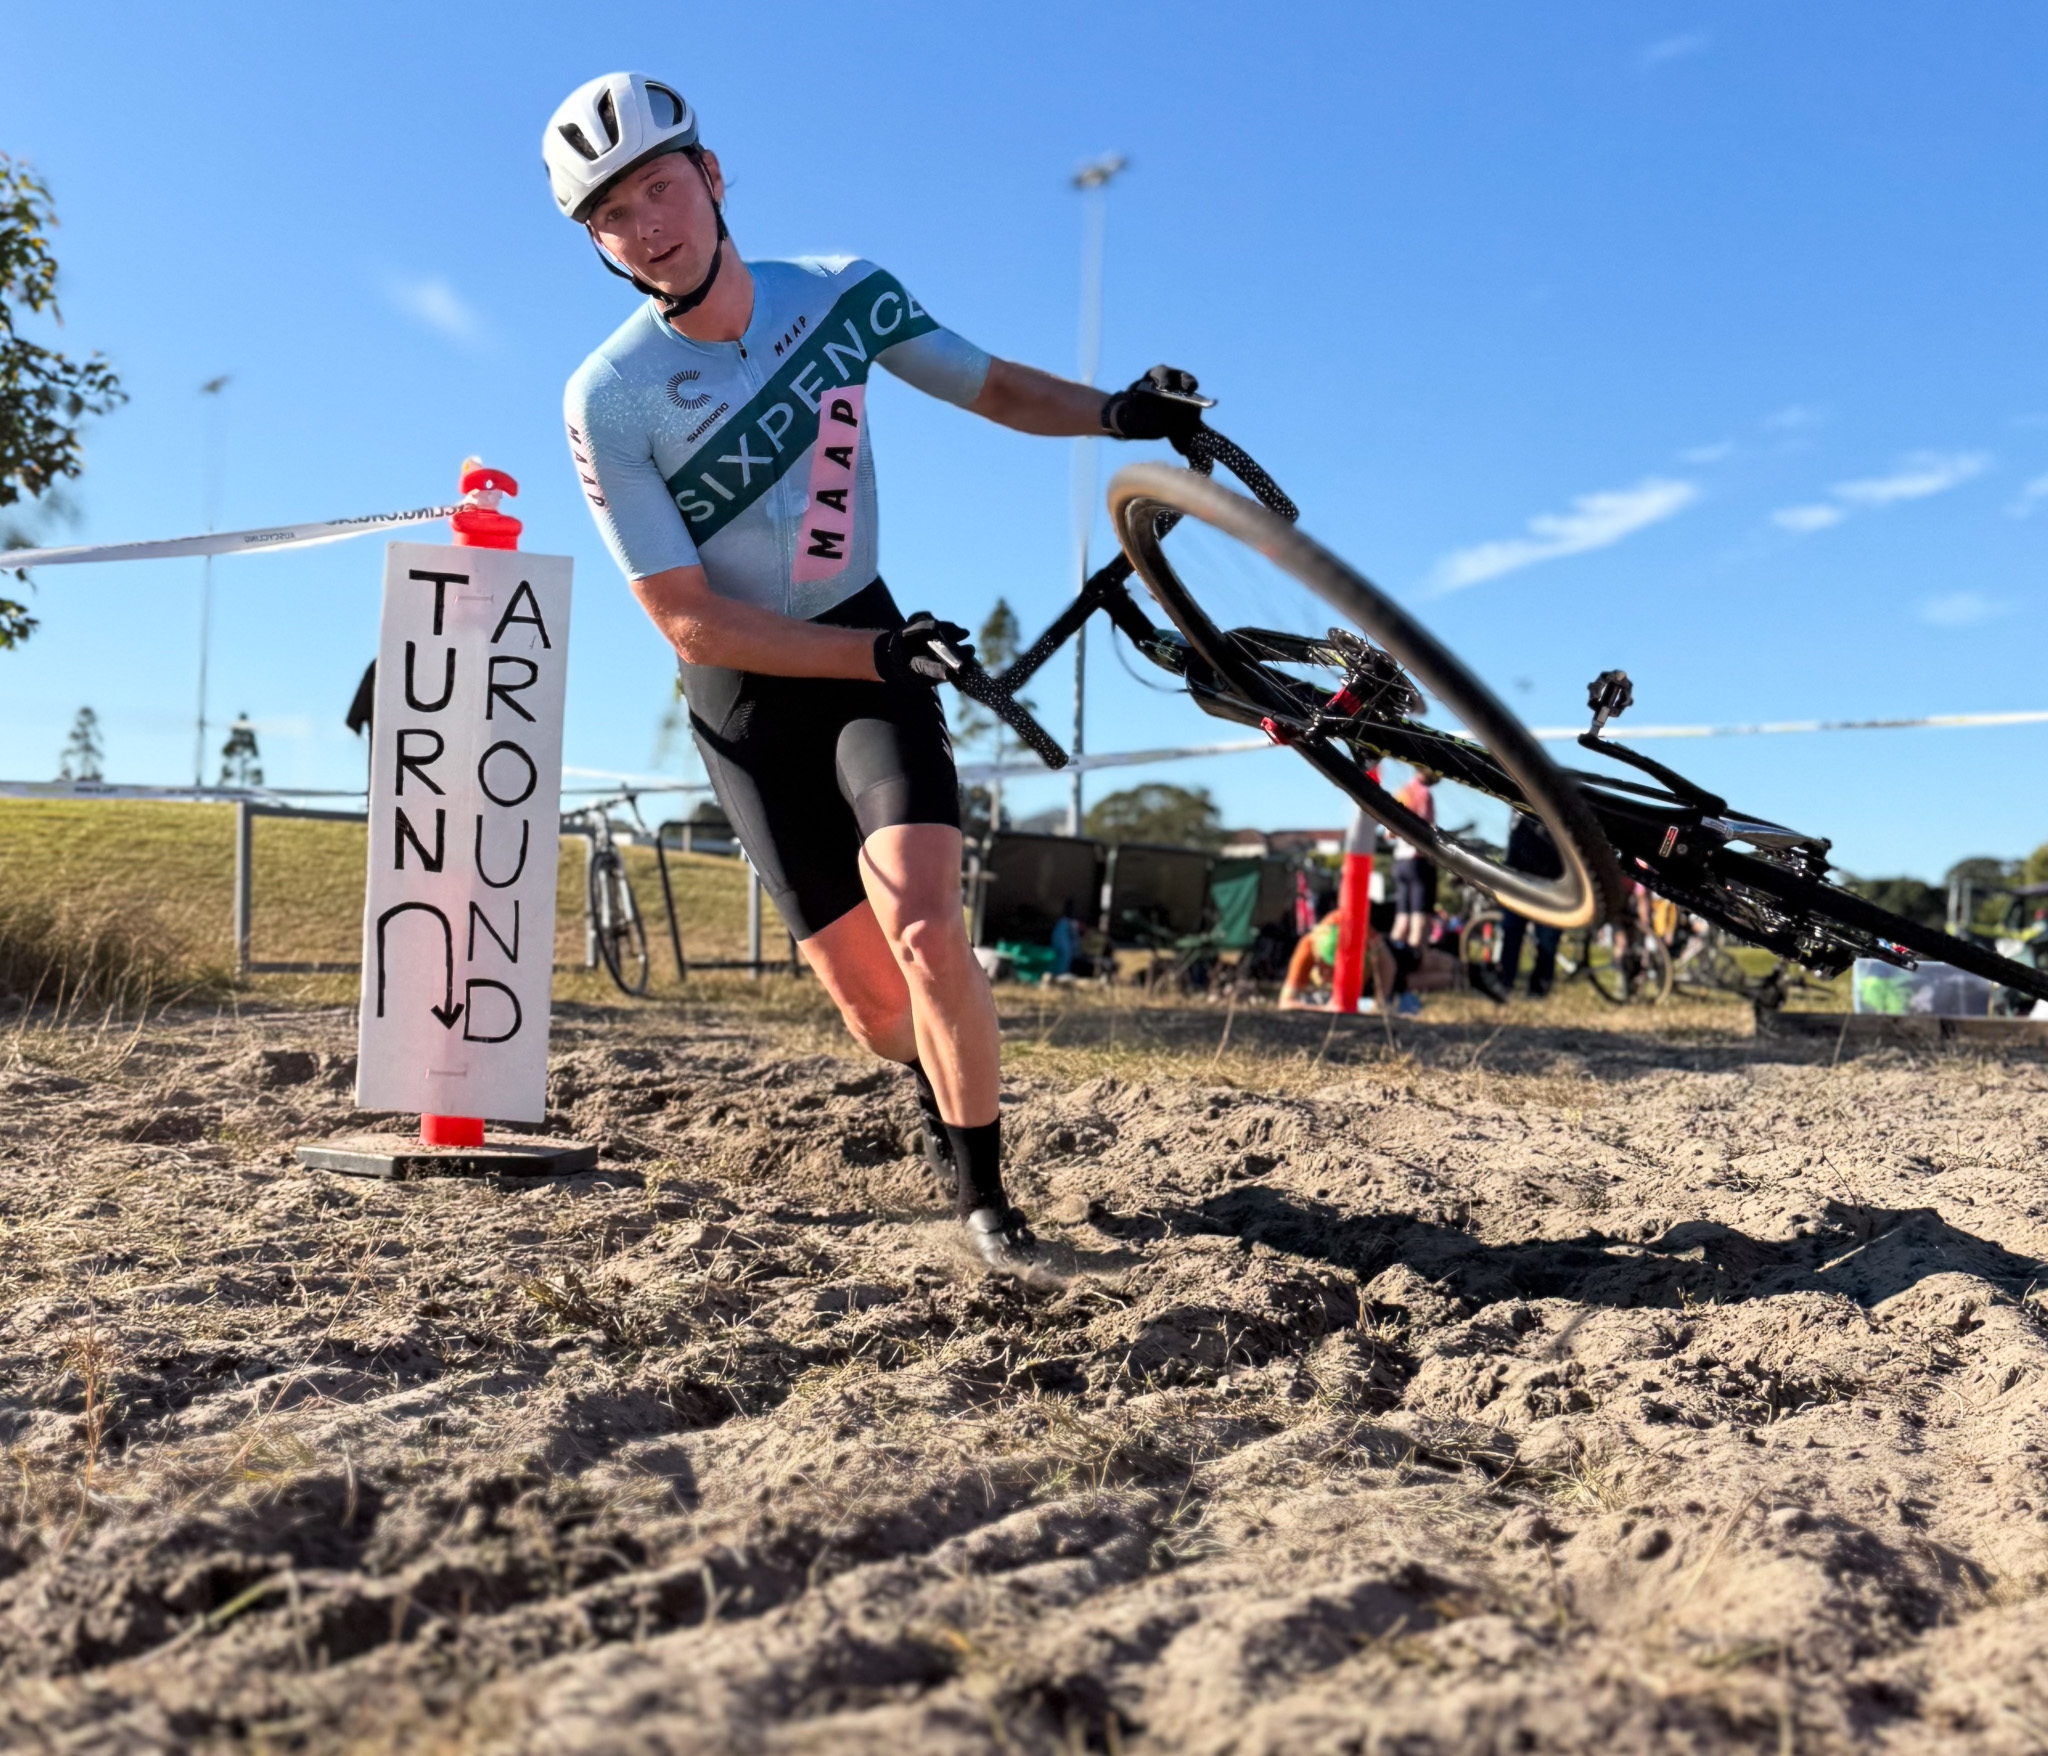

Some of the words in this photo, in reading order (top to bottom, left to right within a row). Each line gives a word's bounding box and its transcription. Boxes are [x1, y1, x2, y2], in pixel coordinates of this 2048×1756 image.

[774, 315, 807, 357] MAAP
[567, 422, 606, 507] MAAP
[686, 402, 730, 444] SHIMANO
[808, 397, 859, 560] MAAP
[395, 569, 470, 873] TURN
[462, 580, 552, 1044] AROUND
